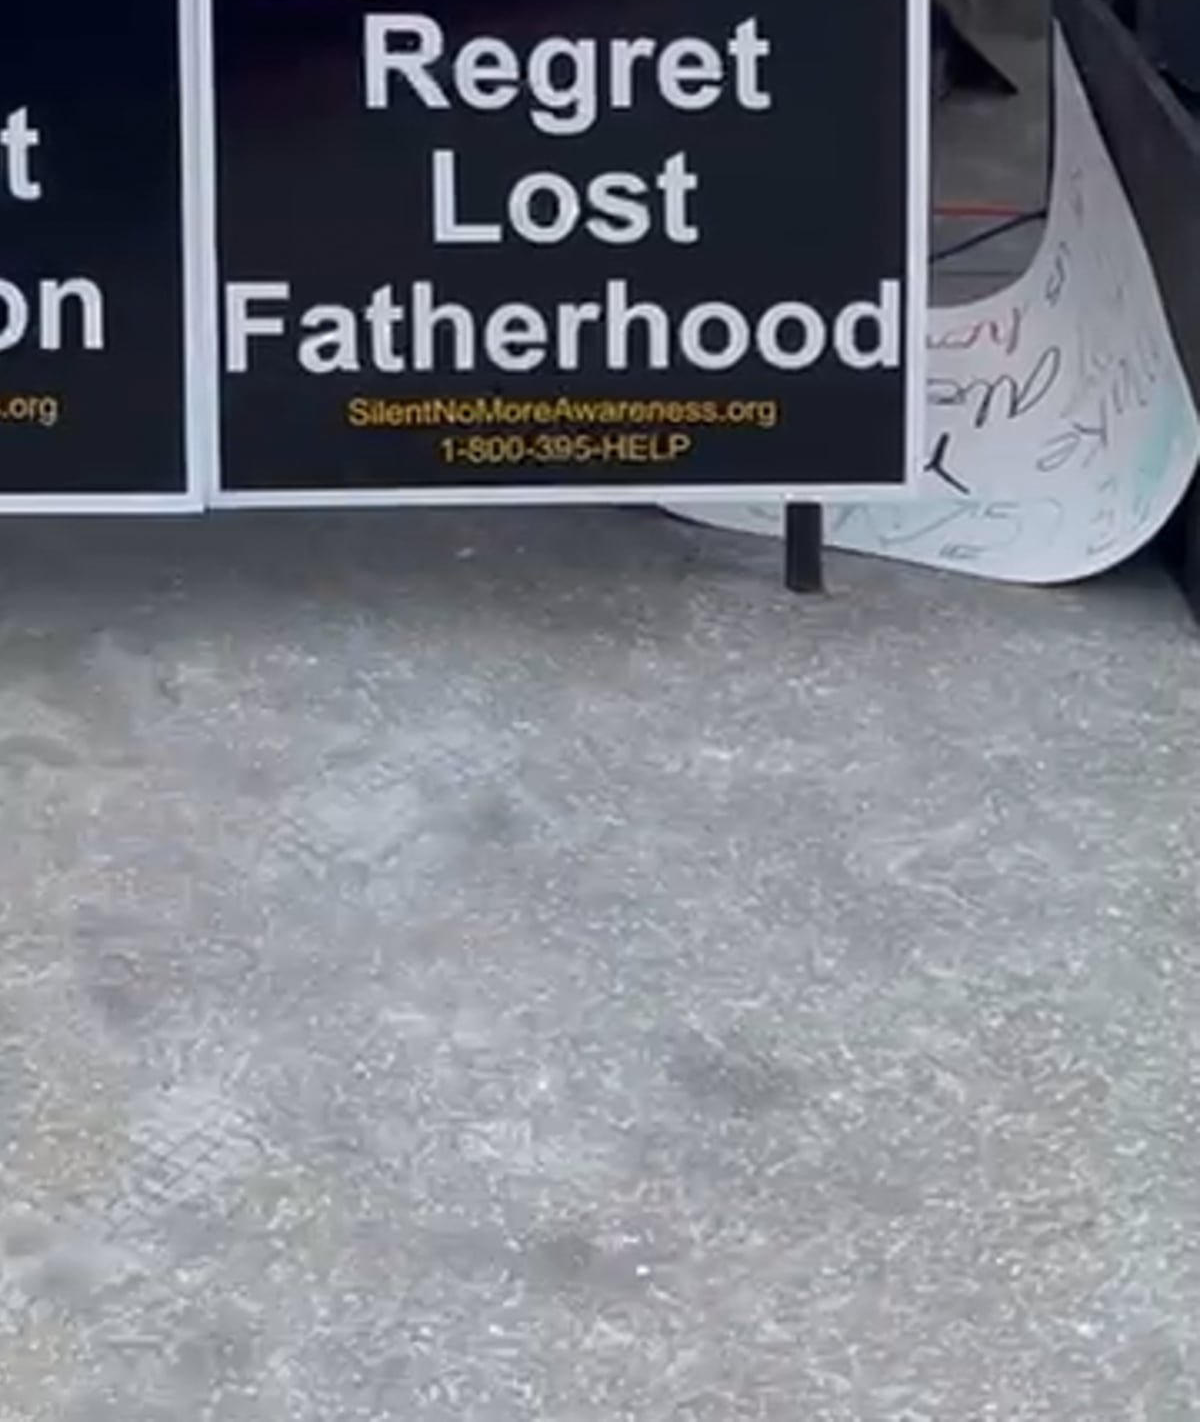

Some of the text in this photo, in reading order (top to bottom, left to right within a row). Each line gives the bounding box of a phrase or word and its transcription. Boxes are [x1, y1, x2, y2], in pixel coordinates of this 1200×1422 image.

[364, 13, 771, 135] Regret
[432, 149, 699, 244] Lost
[225, 278, 901, 374] Fatherhood
[348, 396, 777, 428] SilentNoMoreAwareness.org
[441, 432, 691, 464] 1-800-395-HELP
